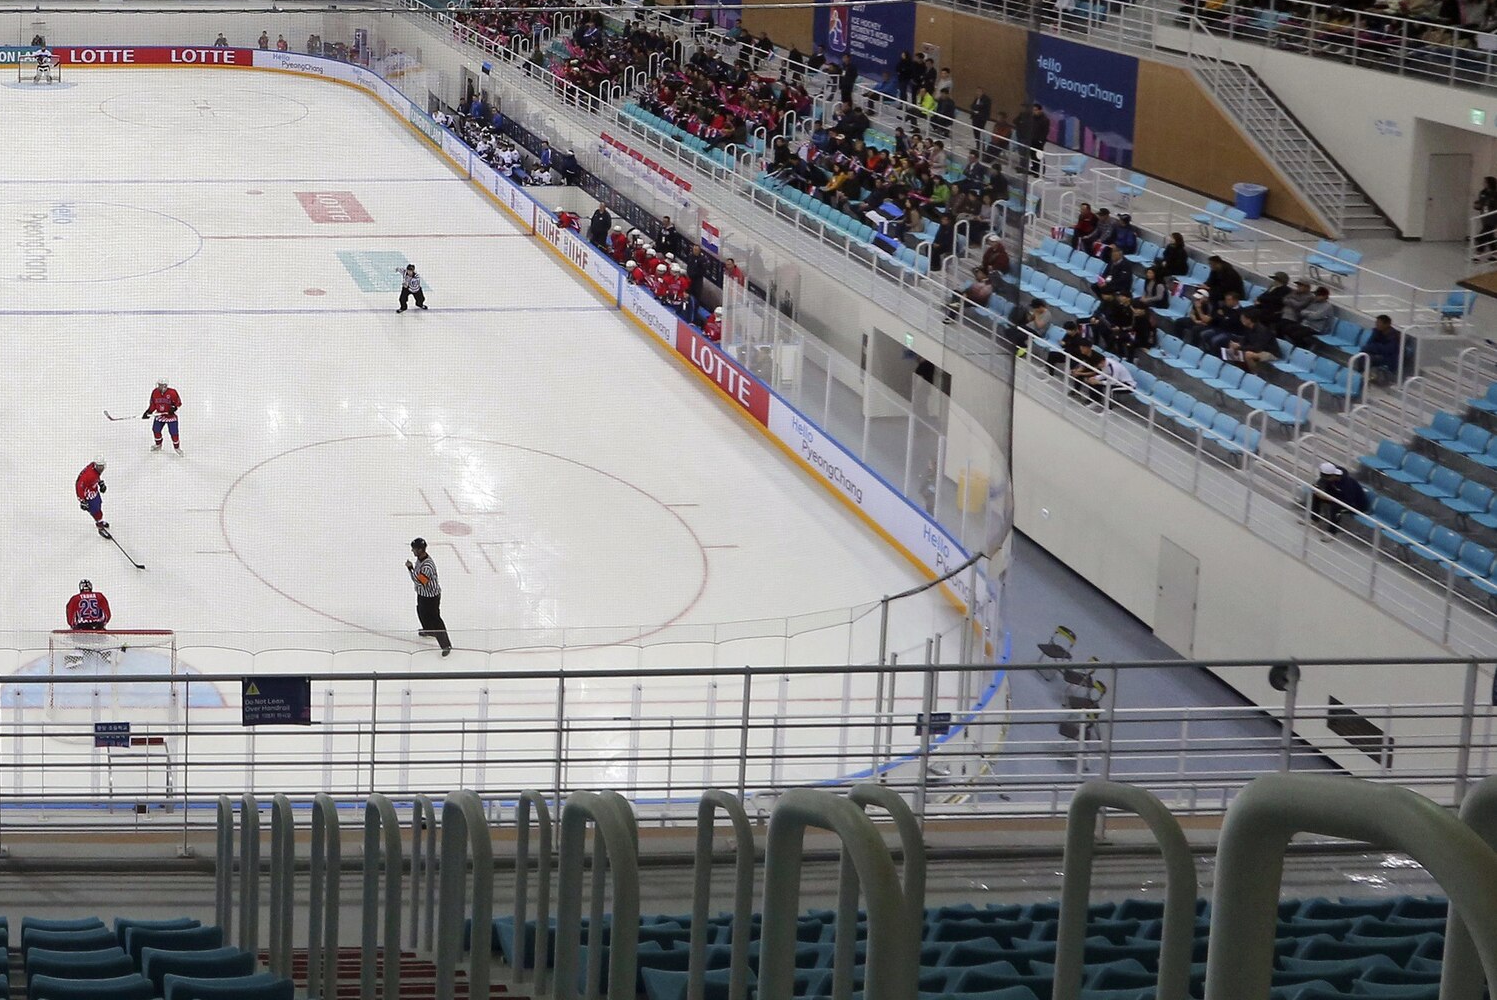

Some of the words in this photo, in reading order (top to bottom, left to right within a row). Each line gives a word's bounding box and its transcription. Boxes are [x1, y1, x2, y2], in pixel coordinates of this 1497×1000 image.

[70, 50, 134, 63] LOTTE
[170, 50, 235, 63] LOTTE
[272, 53, 290, 61] Hello
[282, 61, 324, 74] PyeongChang
[1047, 72, 1124, 108] PyeongChang
[316, 194, 352, 221] LOTTE
[543, 218, 561, 246] IIHF
[569, 238, 589, 270] IIHF
[633, 299, 671, 341] PyeongChang
[691, 335, 751, 407] LOTTE
[792, 416, 814, 443] Hello
[802, 440, 863, 504] PyeongChang
[923, 524, 950, 558] Hello
[79, 598, 100, 619] 25
